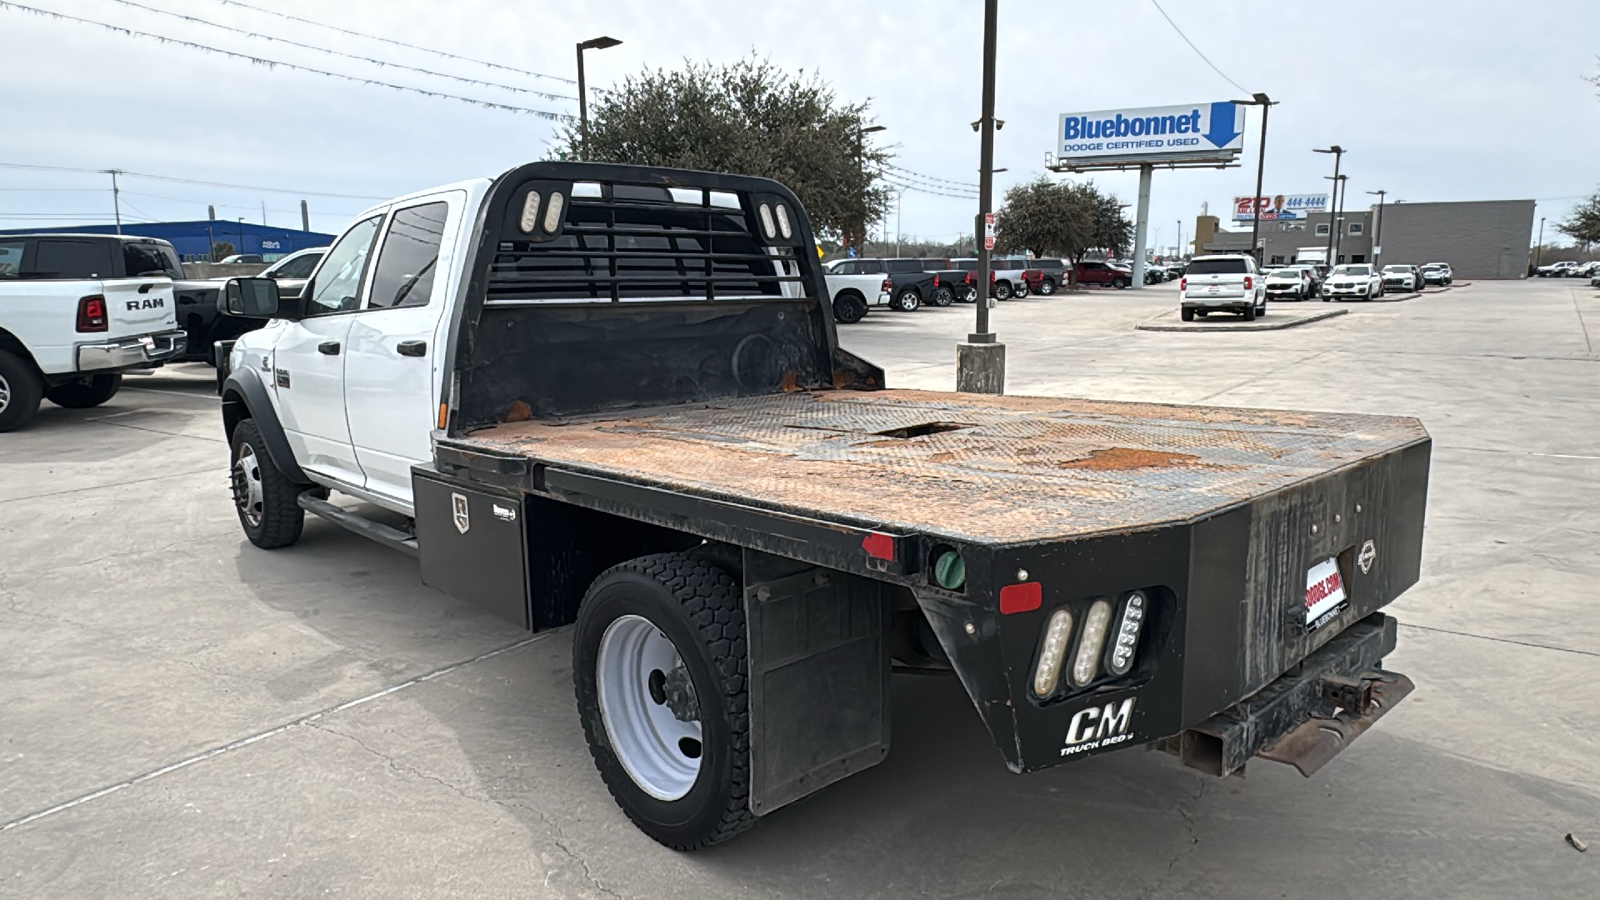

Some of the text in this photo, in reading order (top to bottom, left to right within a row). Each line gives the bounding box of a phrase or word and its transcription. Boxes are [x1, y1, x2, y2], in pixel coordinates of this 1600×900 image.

[1064, 109, 1201, 140] Bluebonnet
[1064, 137, 1200, 152] DODGE CERTIFIED USED
[126, 298, 164, 311] RAM
[1065, 697, 1137, 745] CM
[1060, 741, 1100, 756] TRUCK
